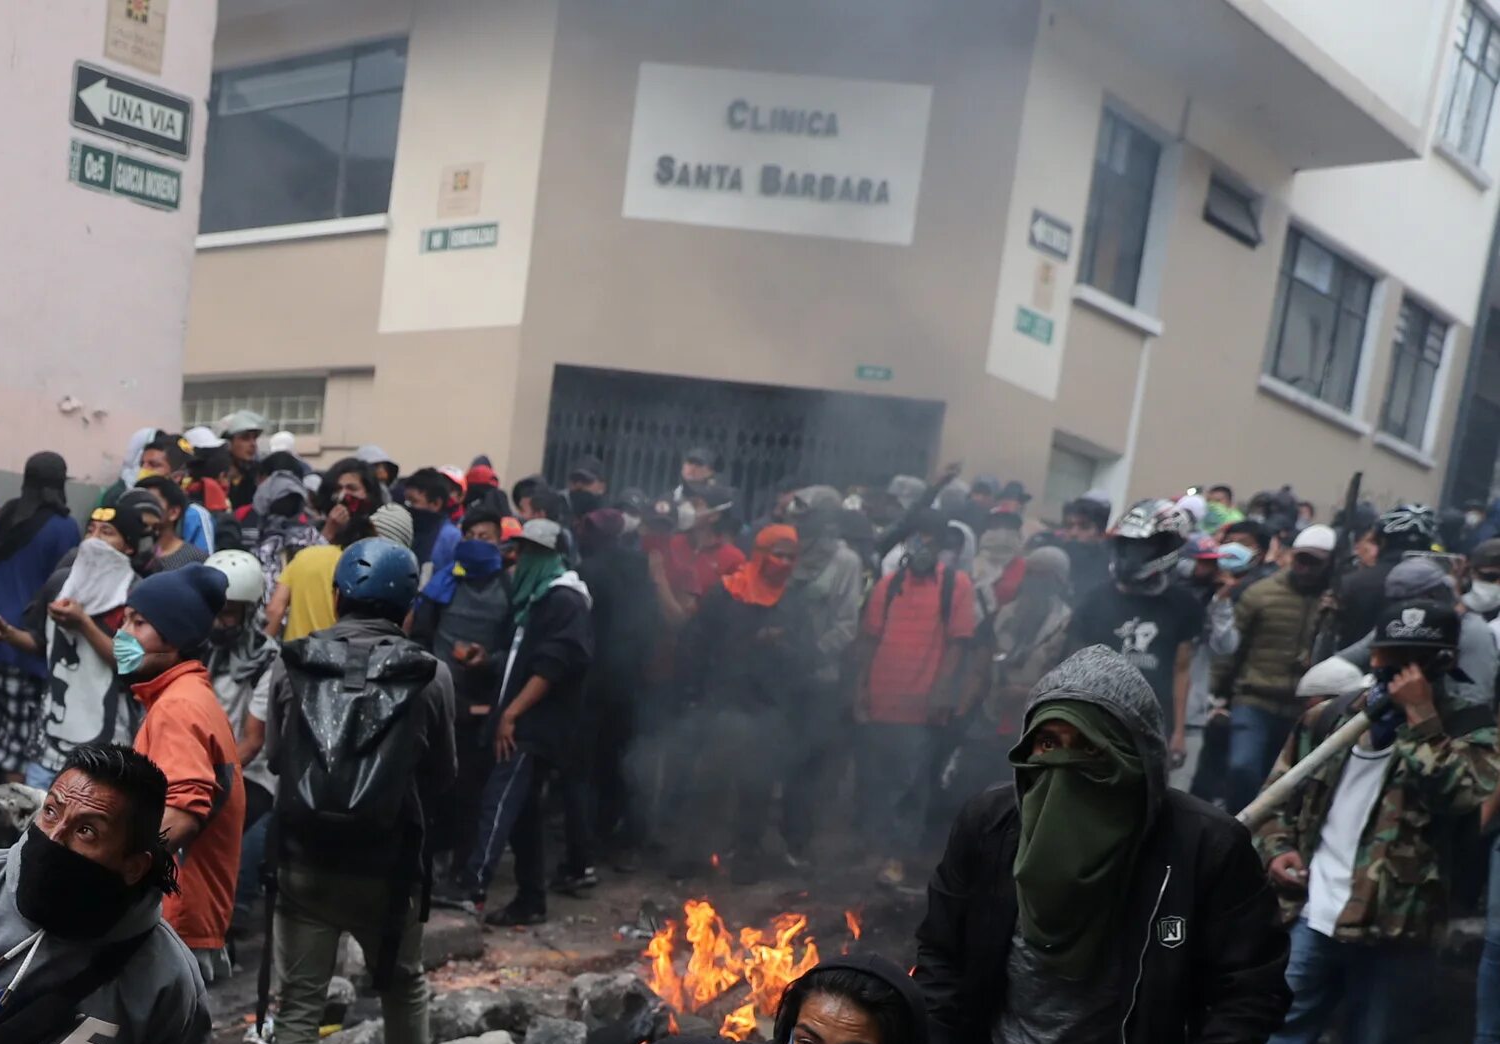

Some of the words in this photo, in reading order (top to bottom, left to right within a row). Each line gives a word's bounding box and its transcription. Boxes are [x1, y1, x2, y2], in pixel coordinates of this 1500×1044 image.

[108, 94, 144, 126] UNA
[150, 105, 177, 136] VIA
[116, 162, 144, 194] GARCIA
[145, 170, 178, 203] MORENO
